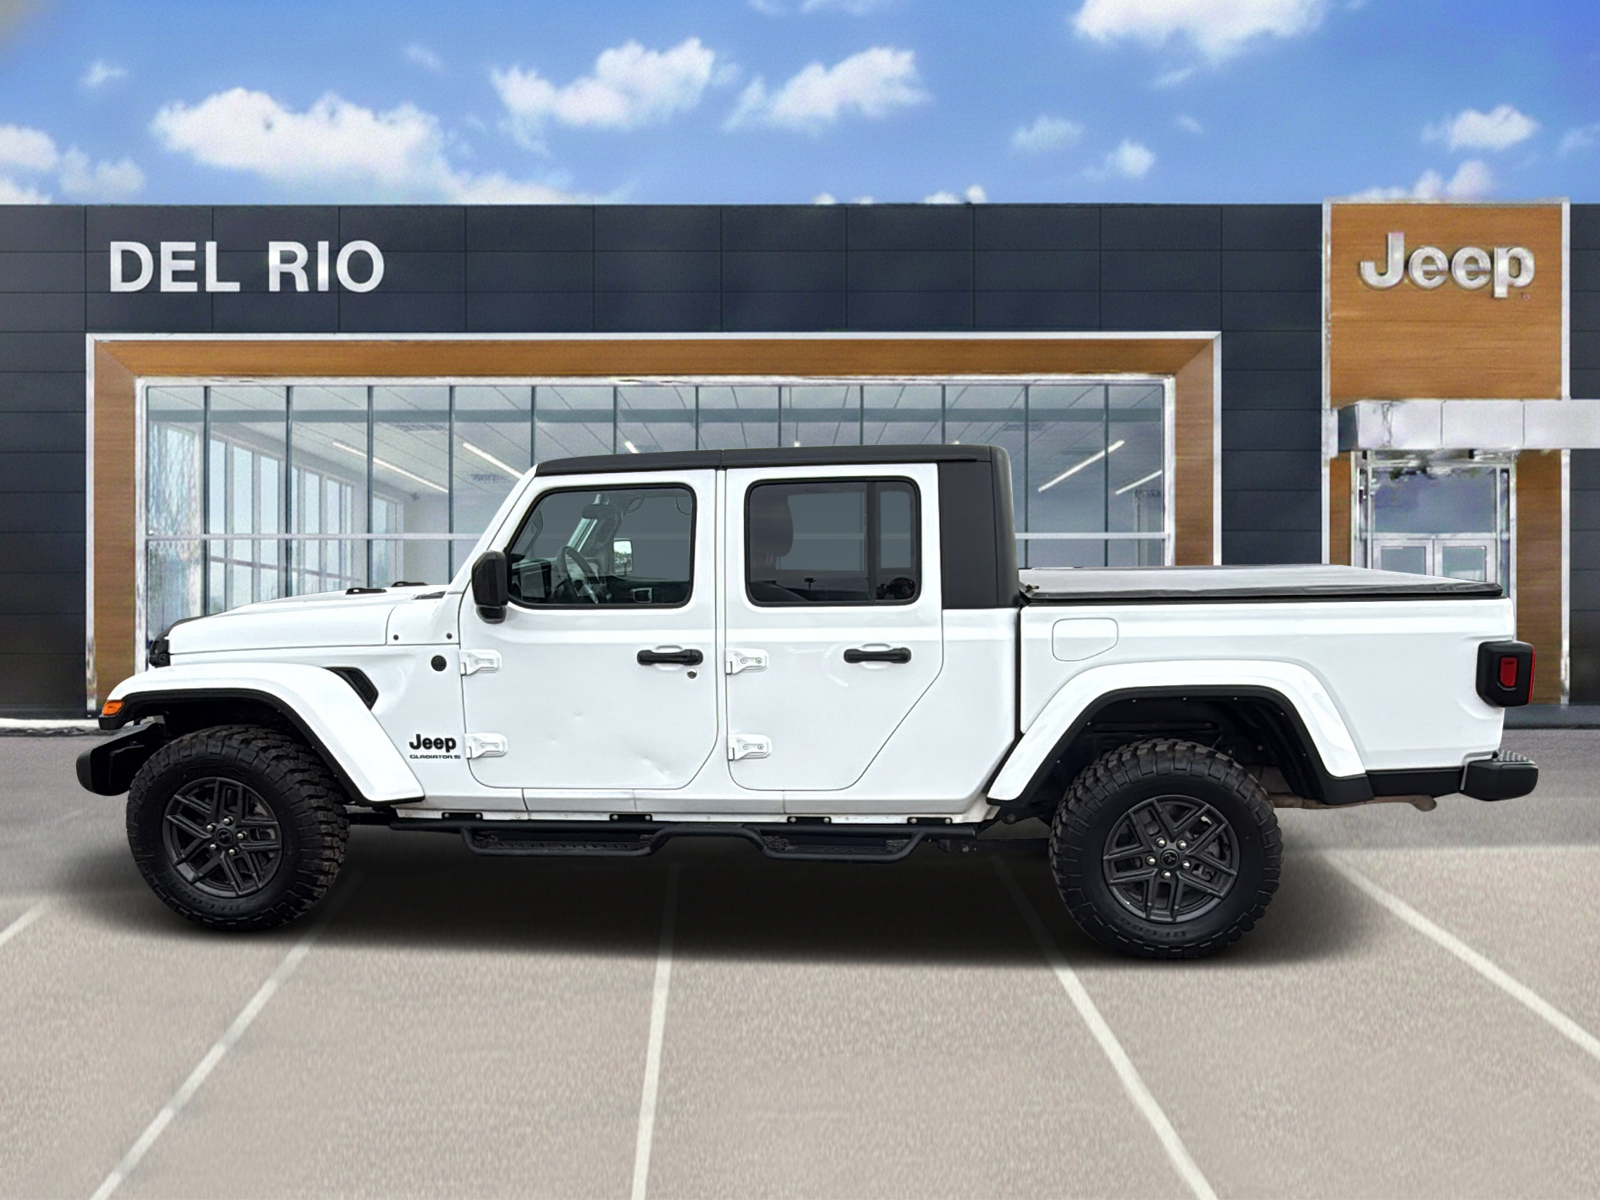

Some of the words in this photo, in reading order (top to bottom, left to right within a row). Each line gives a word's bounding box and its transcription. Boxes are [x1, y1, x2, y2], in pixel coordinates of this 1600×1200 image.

[109, 240, 241, 292] DEL
[268, 240, 385, 293] RIO
[1360, 231, 1536, 298] Jeep
[409, 733, 457, 753] Jeep
